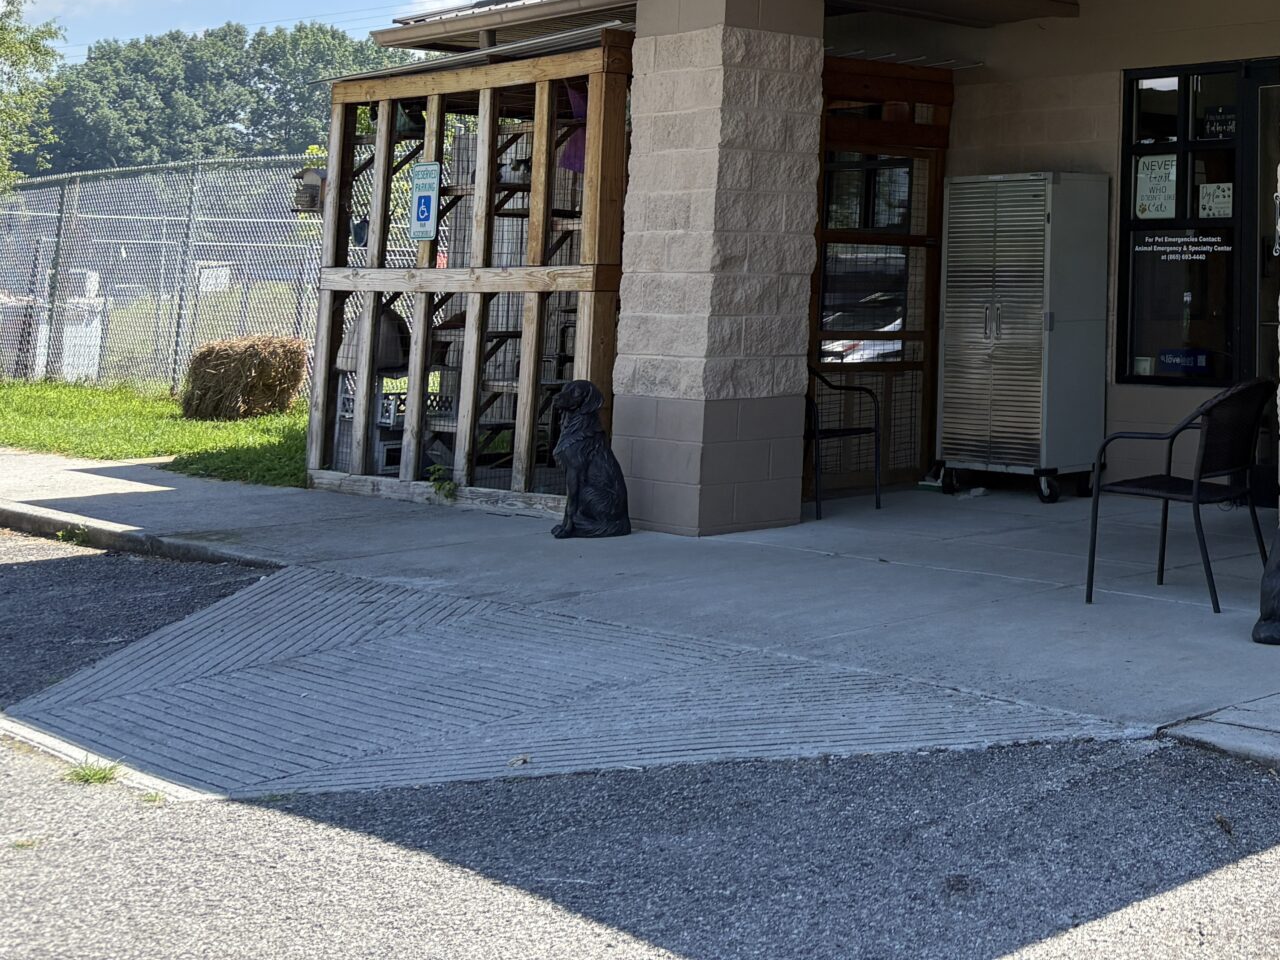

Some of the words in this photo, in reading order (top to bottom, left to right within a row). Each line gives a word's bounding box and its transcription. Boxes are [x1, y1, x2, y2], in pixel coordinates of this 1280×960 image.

[415, 169, 437, 180] RESERVED
[415, 182, 436, 192] PARKING
[1148, 185, 1167, 194] WHO
[1164, 236, 1198, 244] Emergencies
[1153, 245, 1182, 253] Emergency
[1188, 244, 1213, 253] Specialty
